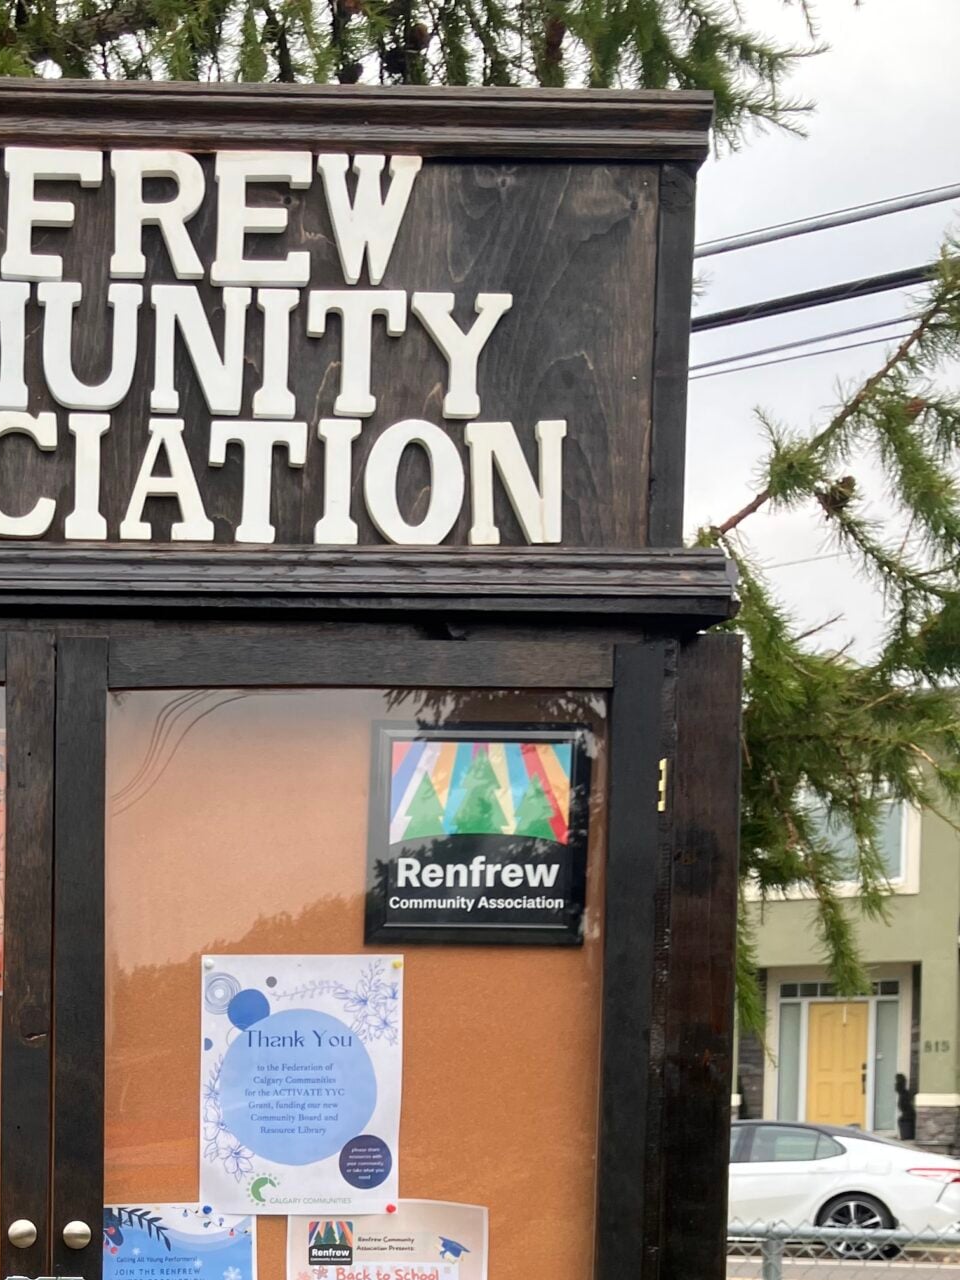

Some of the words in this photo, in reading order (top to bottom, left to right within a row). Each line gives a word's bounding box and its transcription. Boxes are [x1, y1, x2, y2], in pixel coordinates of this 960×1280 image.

[397, 855, 560, 888] Renfrew
[390, 896, 475, 912] Community
[477, 896, 564, 910] Association
[243, 1029, 304, 1048] Thank
[312, 1029, 352, 1048] You
[266, 1063, 279, 1071] the
[281, 1063, 323, 1071] Federation
[324, 1063, 335, 1071] of
[253, 1076, 282, 1086] Calgary
[285, 1076, 336, 1084] Communities
[244, 1088, 256, 1097] for
[258, 1088, 270, 1097] the
[272, 1088, 323, 1097] ACTIVATE
[324, 1088, 345, 1097] YYC
[248, 1101, 274, 1110] Grant,
[275, 1101, 306, 1111] funding
[250, 1113, 295, 1123] Community
[298, 1113, 322, 1121] Board
[323, 1113, 338, 1121] and
[260, 1126, 296, 1134] Resource
[298, 1126, 327, 1136] Library
[270, 1197, 301, 1205] CALGARY
[302, 1197, 353, 1205] COMMUNITIES
[383, 1235, 415, 1244] Community
[311, 1248, 351, 1257] Renfrew
[116, 1256, 136, 1264] Calling
[146, 1256, 164, 1264] Young
[114, 1268, 135, 1276] JOIN
[139, 1268, 156, 1276] THE
[160, 1268, 201, 1276] RENFREW
[376, 1269, 391, 1280] to
